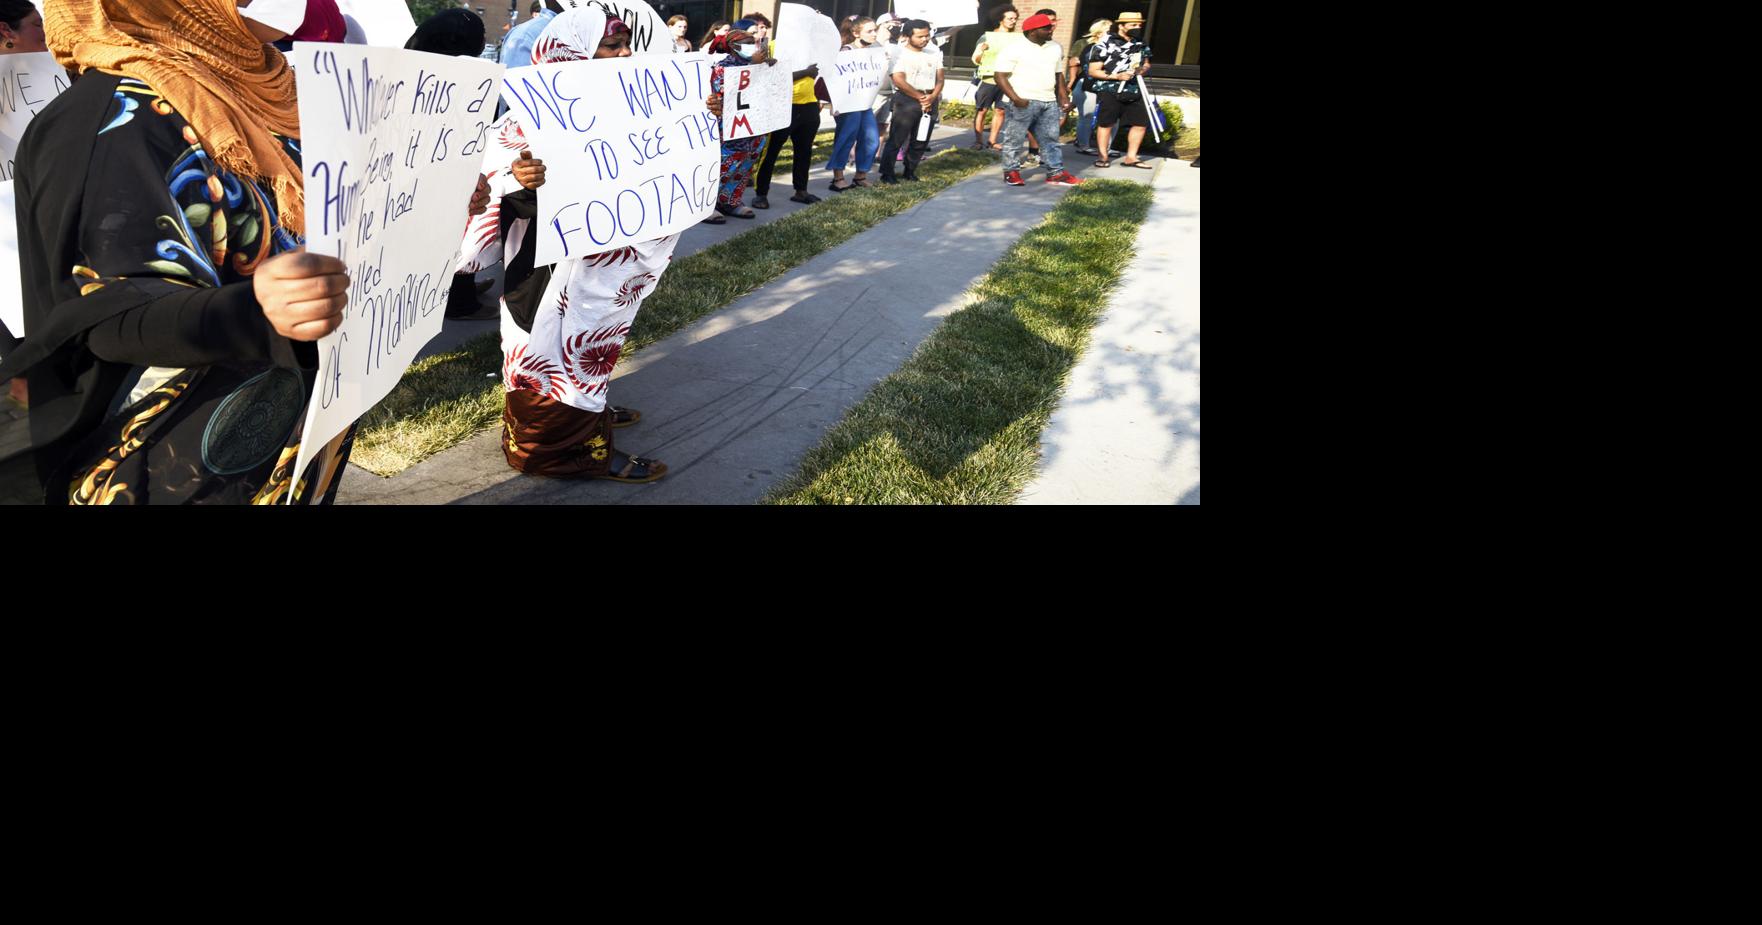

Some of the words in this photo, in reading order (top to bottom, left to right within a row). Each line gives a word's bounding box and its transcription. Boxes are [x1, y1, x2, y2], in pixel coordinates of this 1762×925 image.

[467, 78, 493, 113] a
[503, 70, 596, 133] WE
[618, 59, 705, 119] WANT
[461, 121, 491, 156] as
[584, 138, 619, 181] TO
[628, 126, 671, 166] SEE
[675, 110, 719, 150] THE
[356, 198, 375, 249] he
[383, 177, 418, 230] had
[550, 160, 719, 257] FOOTAGE
